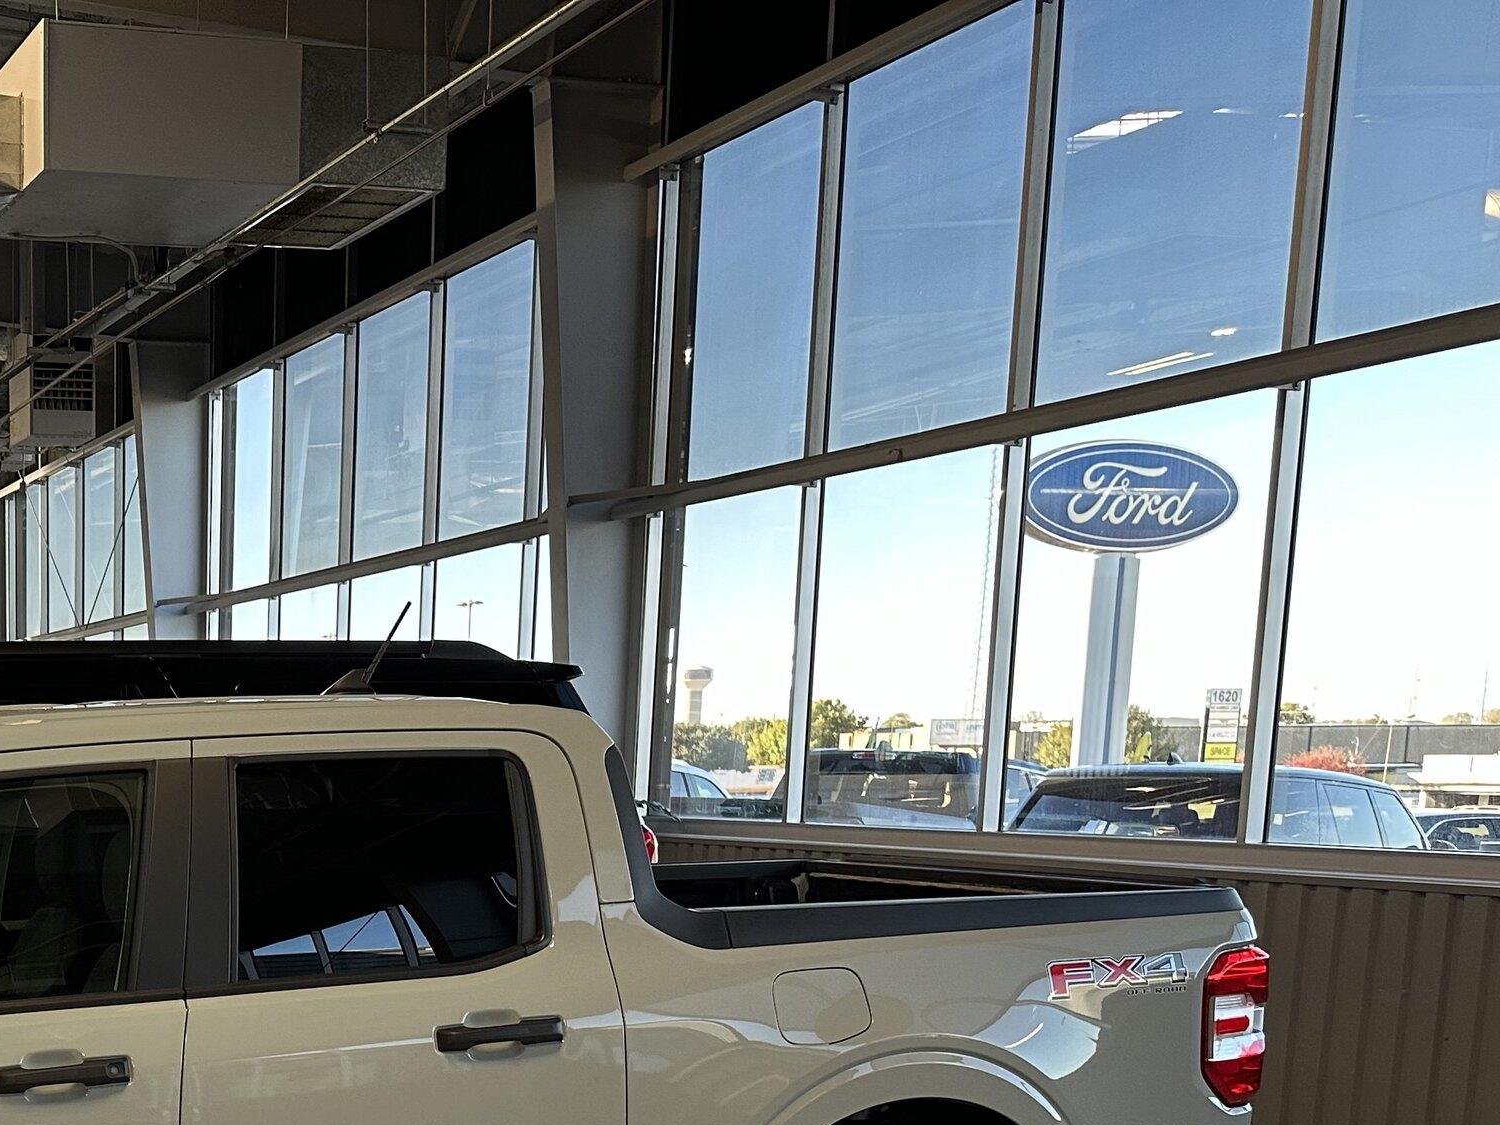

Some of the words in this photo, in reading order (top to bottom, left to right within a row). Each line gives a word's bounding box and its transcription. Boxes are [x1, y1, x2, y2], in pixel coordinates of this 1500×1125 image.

[1067, 461, 1199, 526] Ford
[1213, 690, 1238, 703] 1620
[1046, 951, 1190, 1002] FX4
[1155, 985, 1187, 994] ROAD
